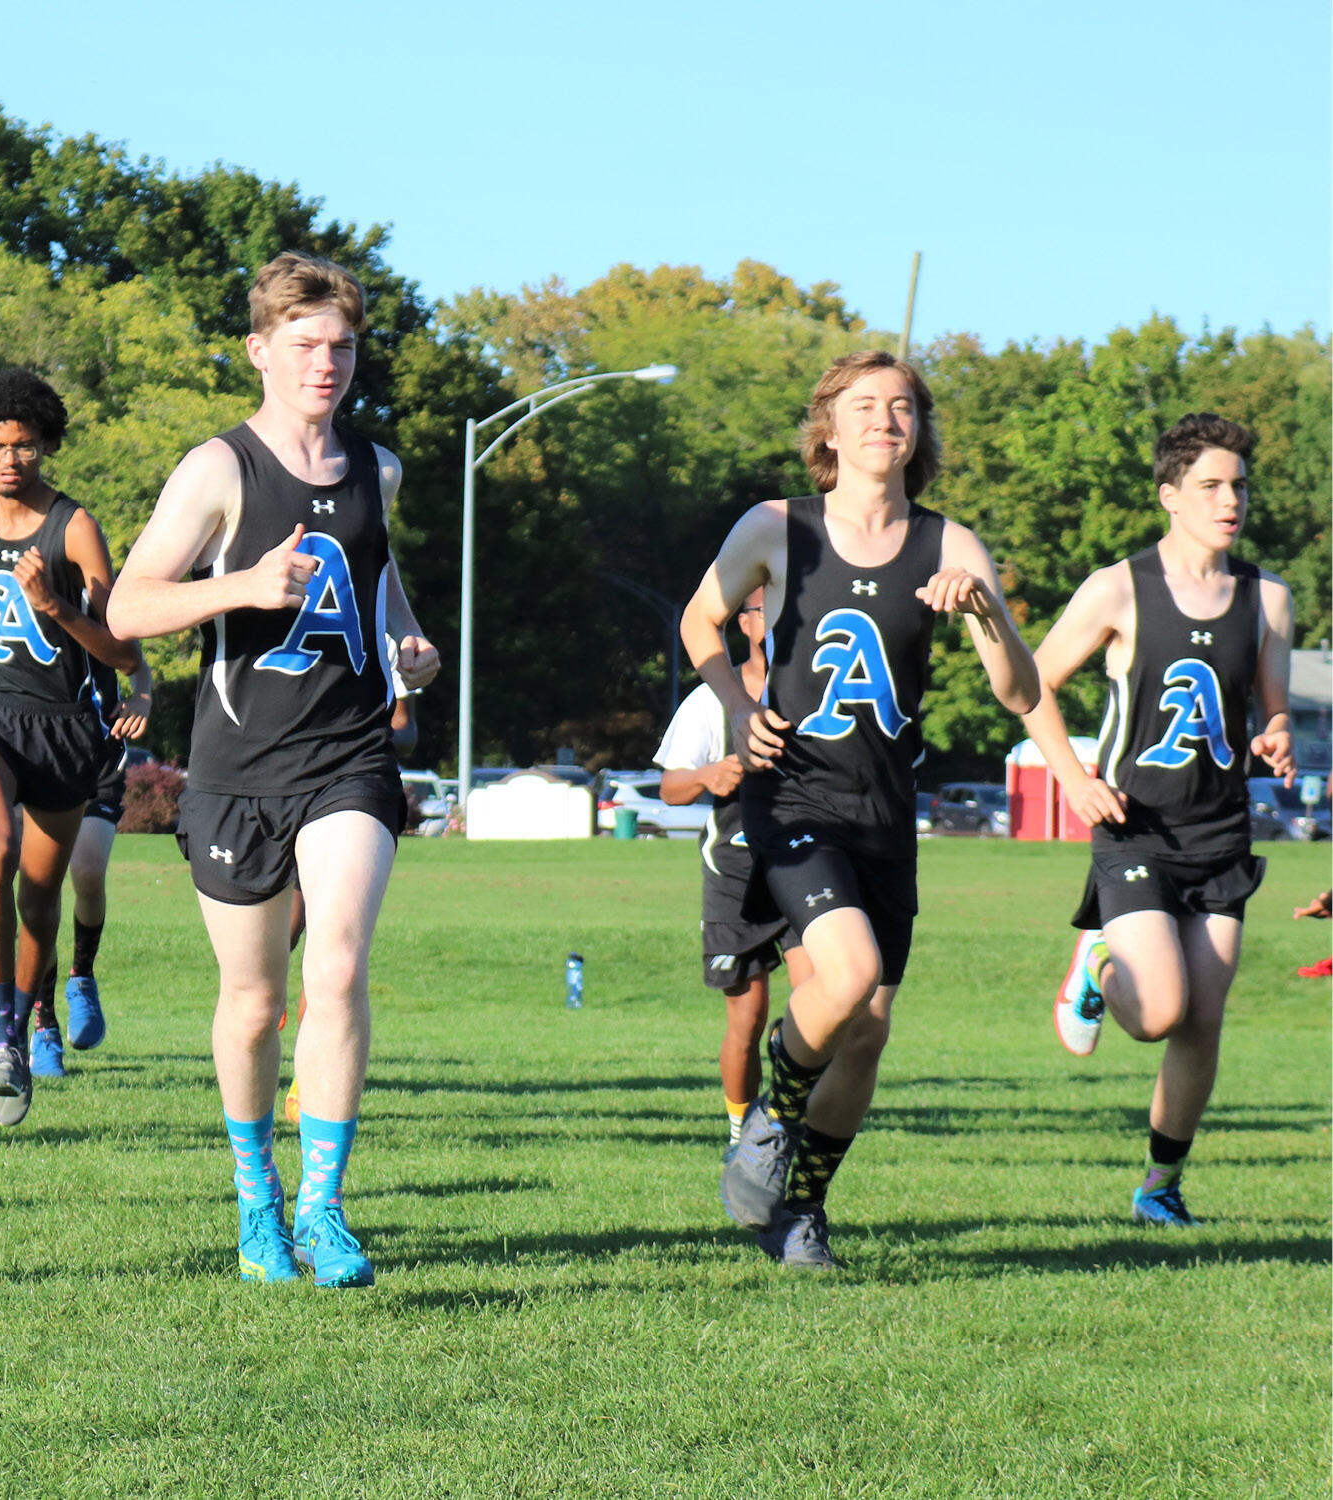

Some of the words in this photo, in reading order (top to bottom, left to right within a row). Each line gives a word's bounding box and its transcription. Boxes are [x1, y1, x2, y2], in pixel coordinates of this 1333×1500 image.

[253, 531, 367, 676] A
[796, 608, 912, 741] A
[1135, 657, 1235, 770] A
